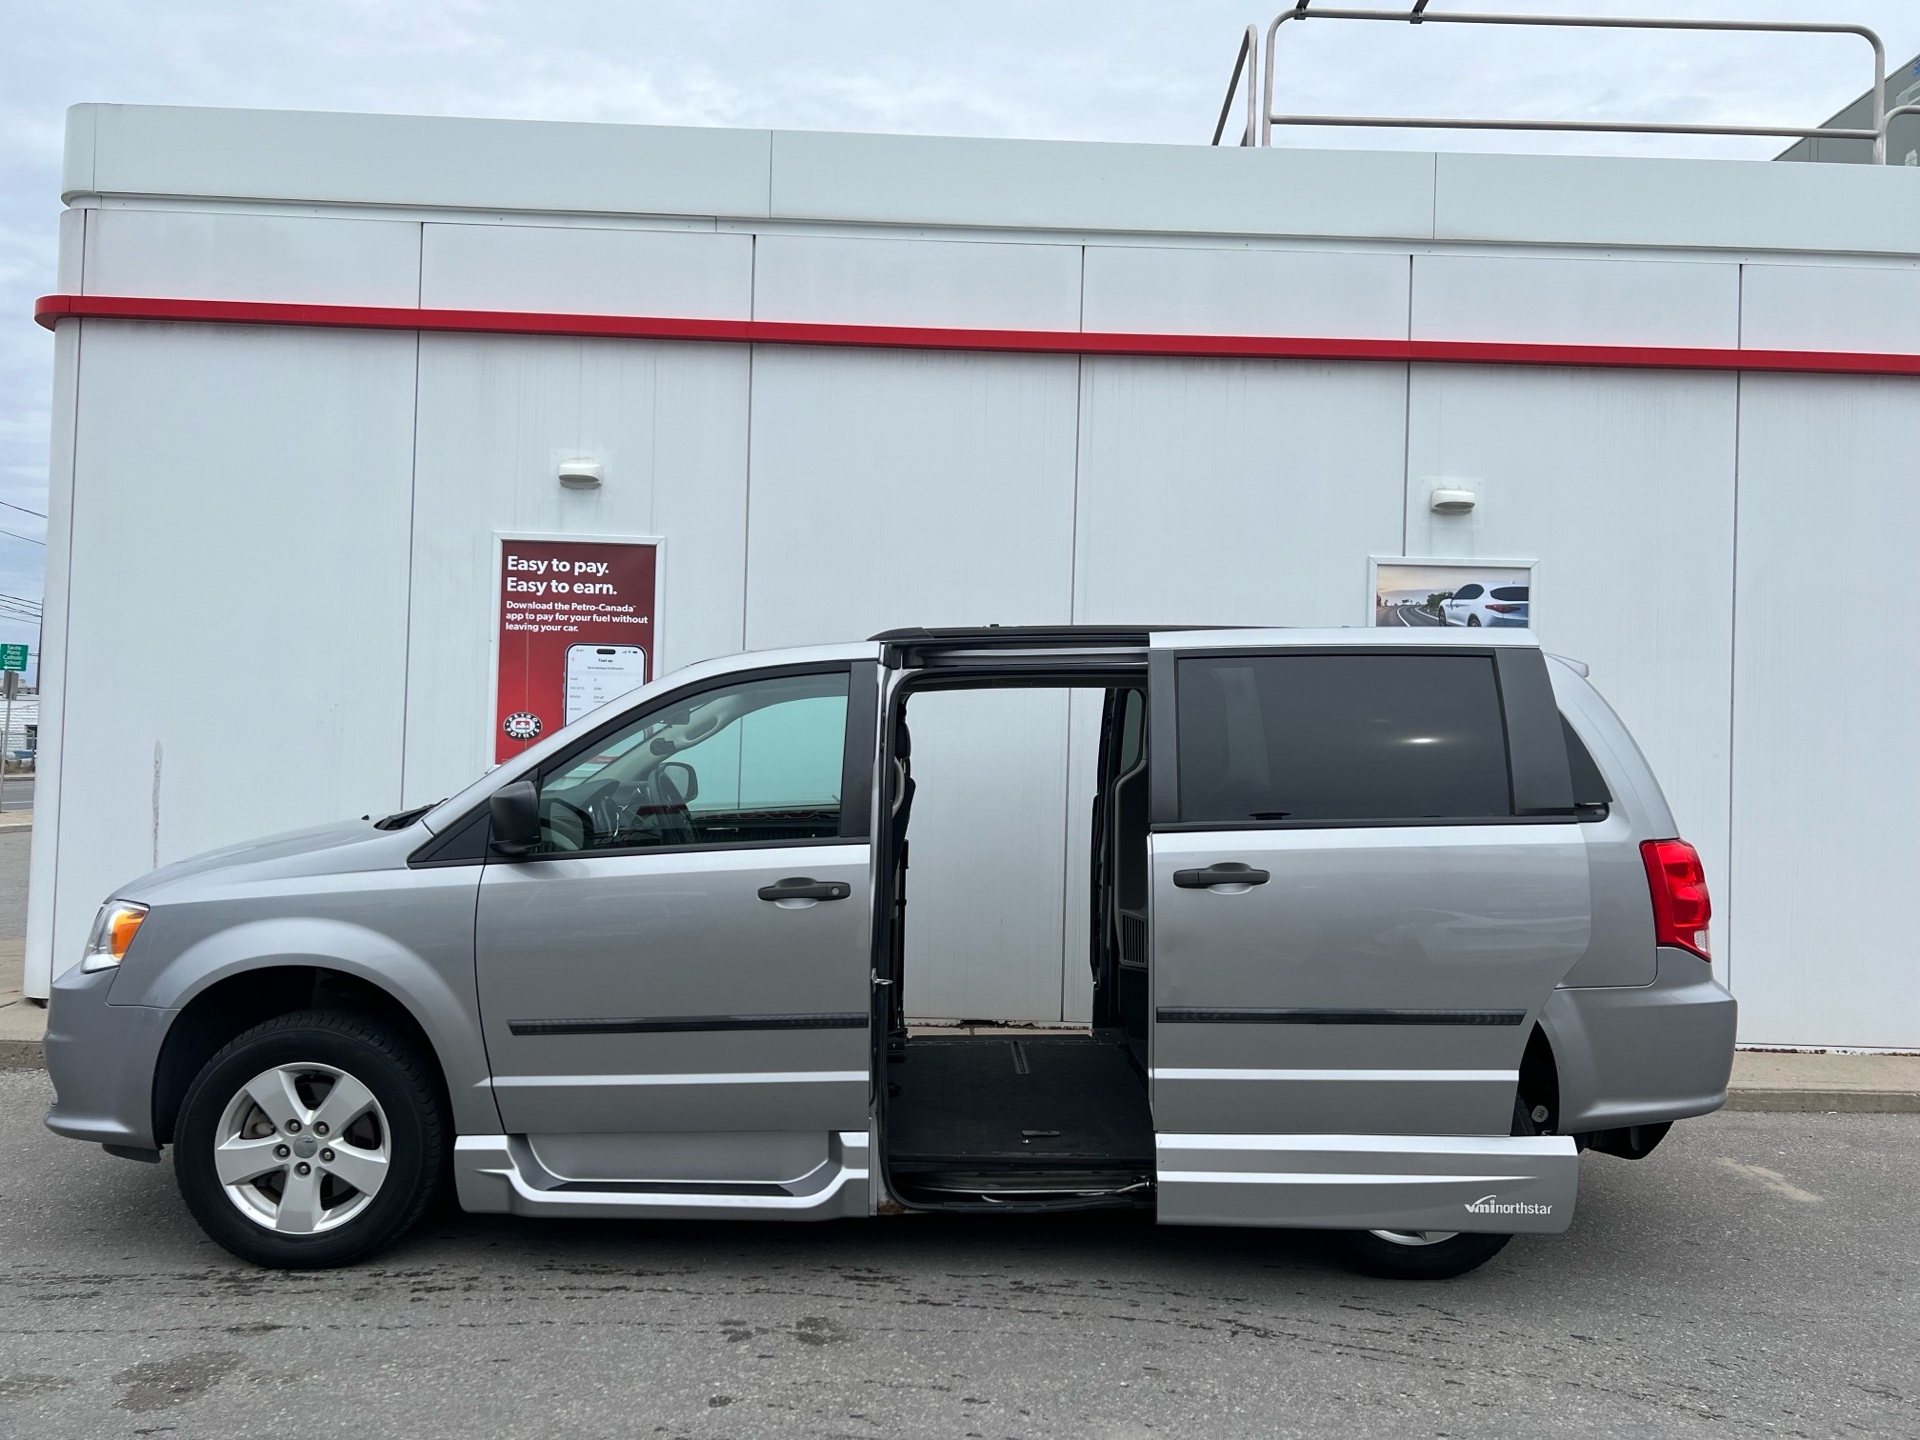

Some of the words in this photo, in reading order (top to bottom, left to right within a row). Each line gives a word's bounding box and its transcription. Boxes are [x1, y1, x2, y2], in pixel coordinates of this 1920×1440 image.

[507, 555, 548, 574] Easy
[551, 558, 571, 572] to
[574, 561, 609, 577] pay.
[506, 576, 548, 595] Easy
[550, 579, 569, 593] to
[573, 582, 617, 595] earn.
[506, 600, 553, 610] Download
[554, 602, 570, 611] the
[505, 613, 524, 621] app
[536, 613, 554, 622] pay
[555, 612, 569, 620] for
[569, 614, 591, 623] your
[592, 613, 610, 622] fuel
[611, 615, 648, 624] without
[505, 622, 539, 632] leaving
[540, 624, 562, 633] your
[508, 713, 538, 722] PETRO
[506, 728, 540, 738] POINTS
